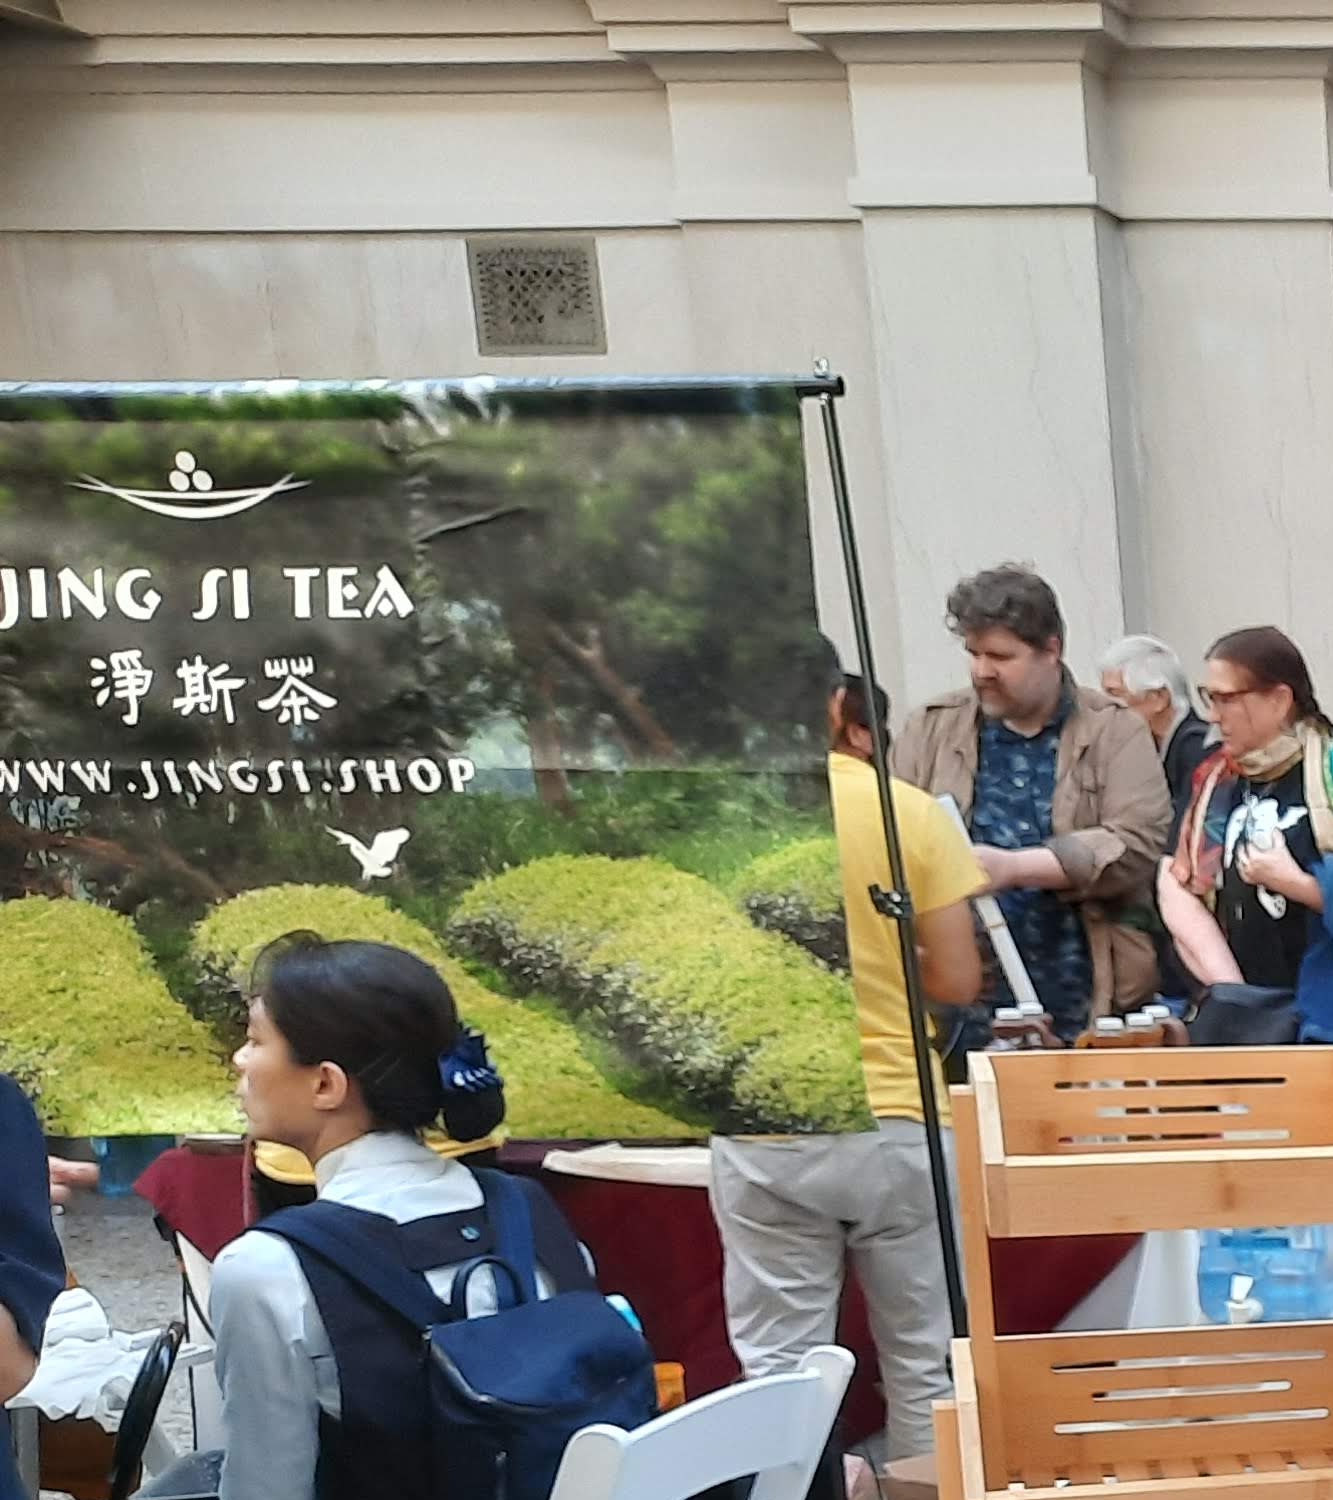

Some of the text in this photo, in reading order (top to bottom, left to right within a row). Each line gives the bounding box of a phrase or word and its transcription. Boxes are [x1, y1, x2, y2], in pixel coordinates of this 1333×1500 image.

[0, 564, 415, 630] JING SI TEA
[89, 649, 338, 726] 淨斯茶
